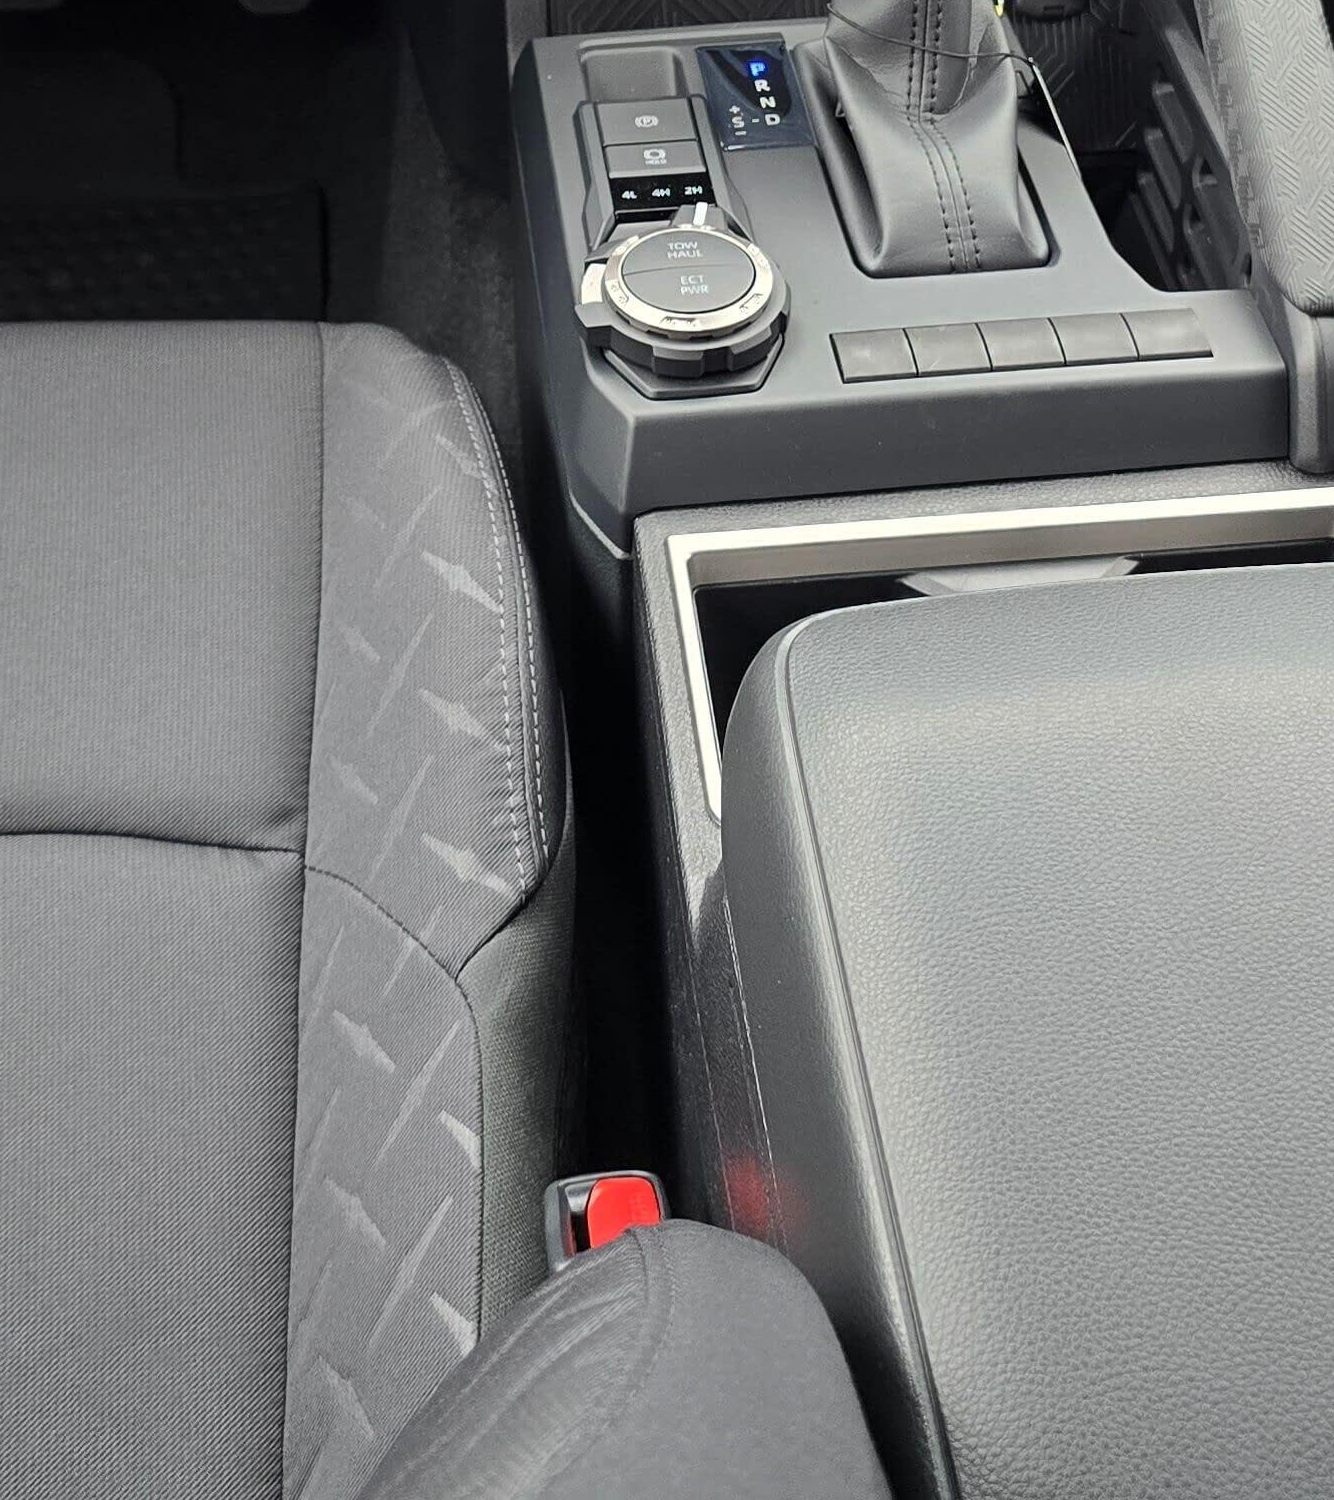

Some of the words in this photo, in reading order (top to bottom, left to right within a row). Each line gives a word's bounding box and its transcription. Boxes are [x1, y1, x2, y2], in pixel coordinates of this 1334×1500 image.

[750, 63, 765, 77] P
[754, 79, 770, 92] R
[760, 96, 776, 109] N
[731, 116, 745, 129] S
[764, 113, 781, 126] D
[621, 190, 637, 200] 4L
[651, 187, 671, 198] 4H
[684, 185, 703, 196] 2H
[668, 241, 698, 250] TOW
[667, 250, 704, 259] HAUL
[680, 275, 705, 285] ECT
[680, 285, 709, 295] PWR
